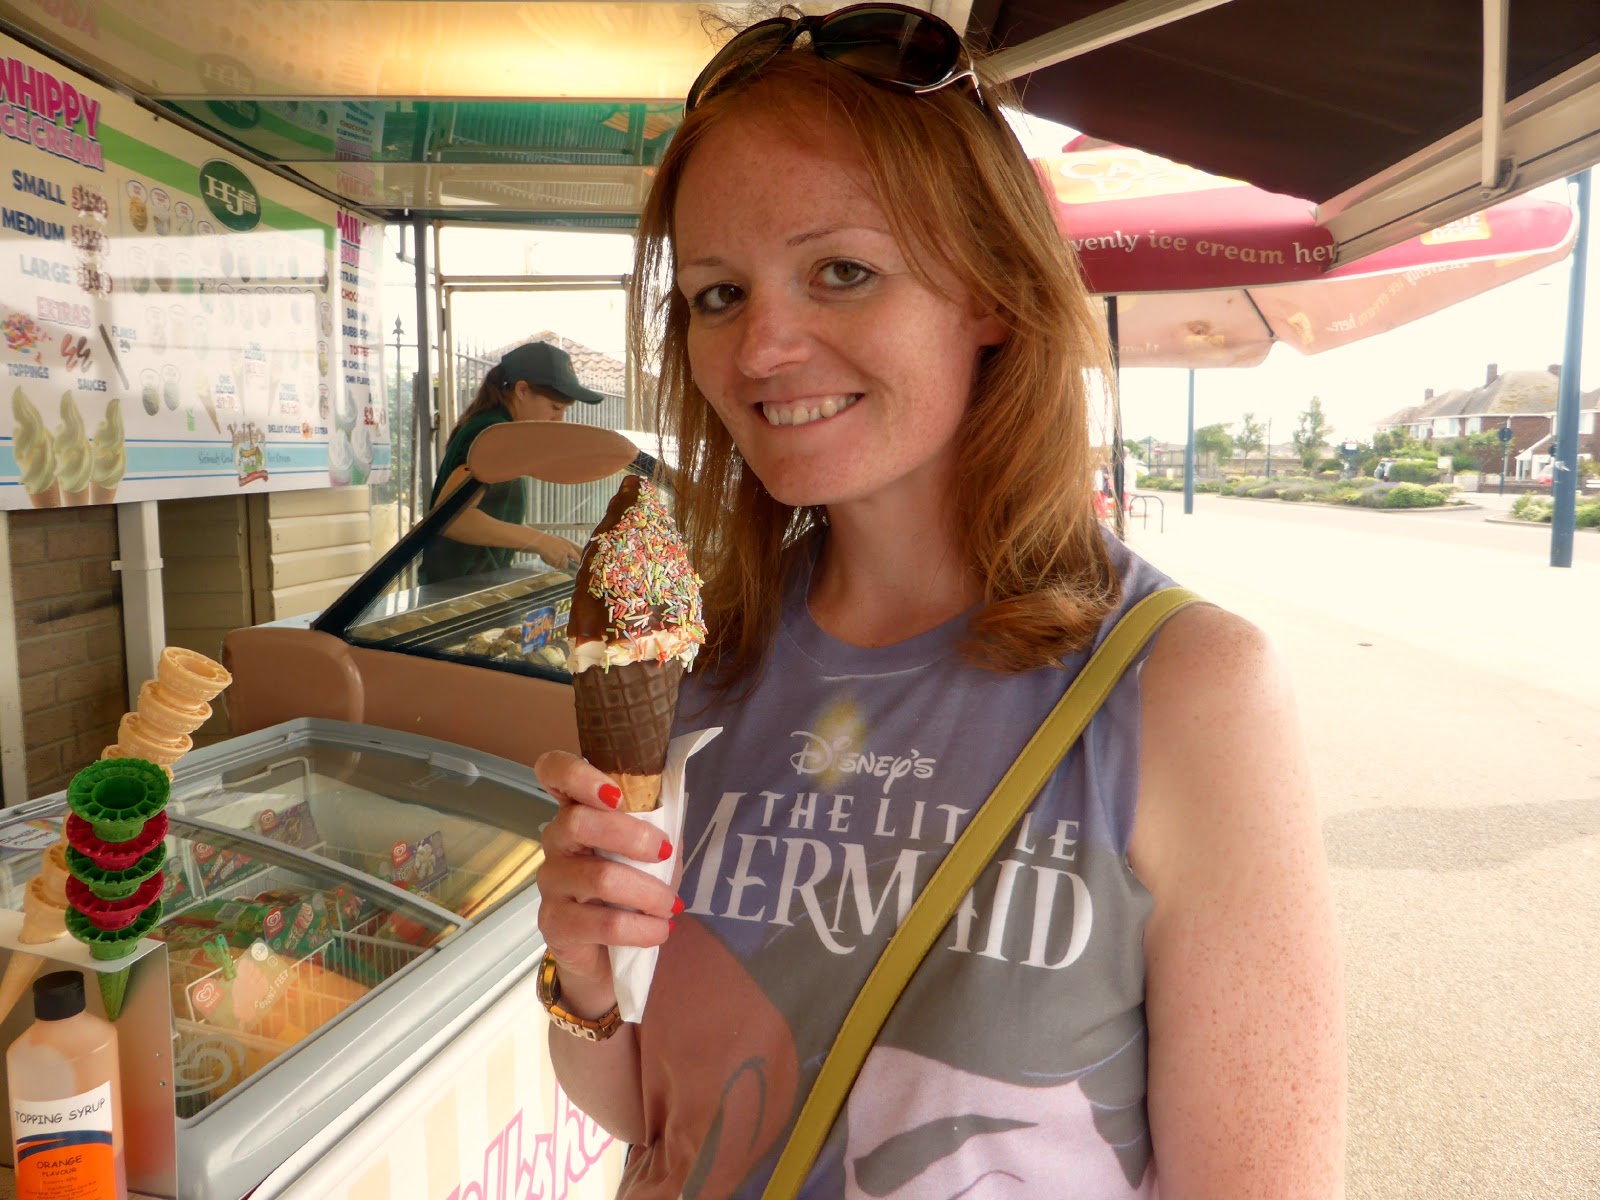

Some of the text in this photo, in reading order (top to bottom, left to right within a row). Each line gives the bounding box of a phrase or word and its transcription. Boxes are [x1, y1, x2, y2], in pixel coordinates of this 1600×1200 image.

[29, 116, 104, 172] CREAM
[12, 169, 66, 205] SMALL
[2, 206, 65, 241] MEDIUM
[1071, 229, 1335, 265] venly ice cream her
[20, 254, 71, 284] LARGE
[36, 295, 91, 329] EXTRAS
[7, 363, 49, 379] TOPPINGS
[77, 378, 107, 392] SAUCES
[759, 790, 1080, 862] THE LITLE
[254, 969, 290, 1009] FUNNY FEET
[15, 1098, 106, 1125] TOPPING SYRUP
[36, 1155, 82, 1169] ORANGE
[42, 1167, 77, 1177] FLAVOUR
